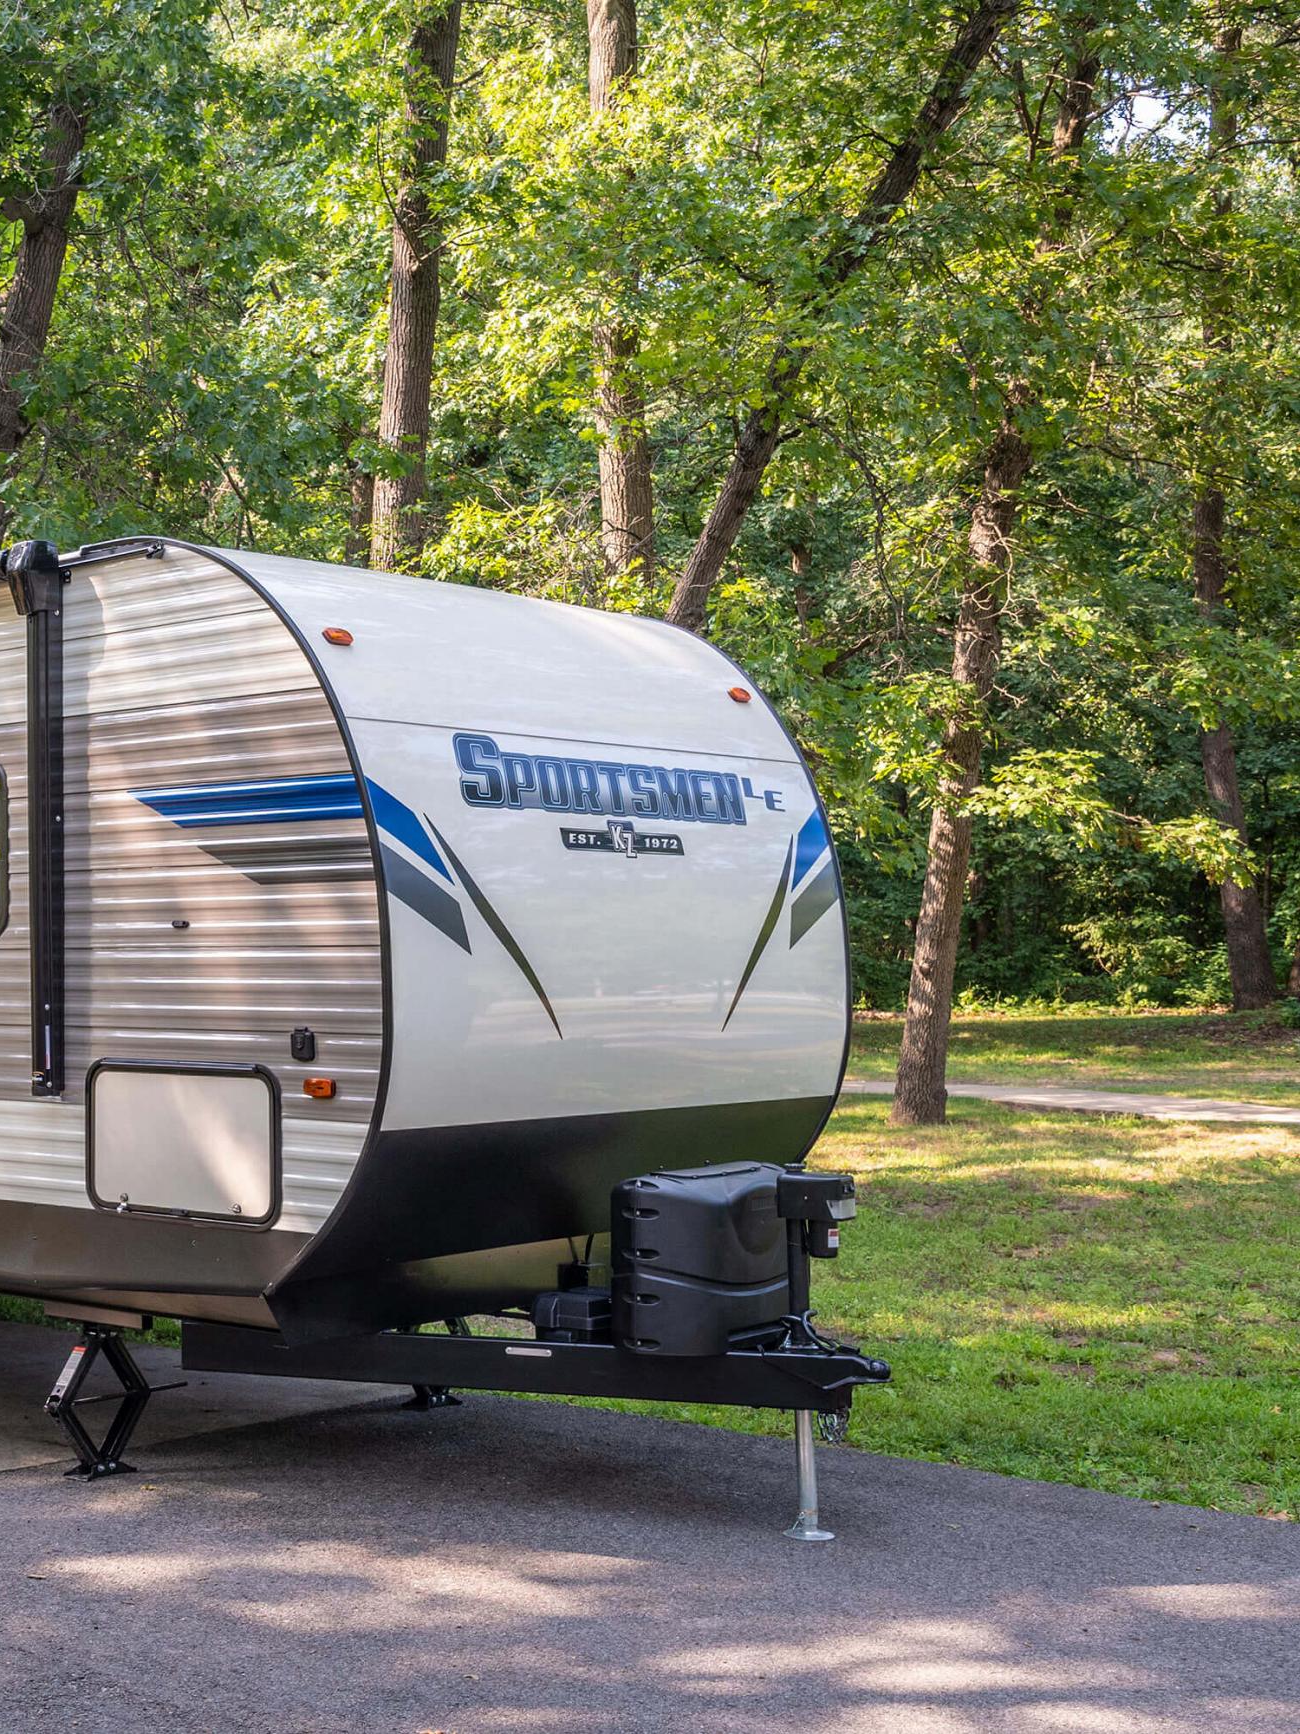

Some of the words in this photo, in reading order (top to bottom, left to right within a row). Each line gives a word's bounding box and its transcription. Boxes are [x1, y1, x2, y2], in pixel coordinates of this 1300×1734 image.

[453, 733, 747, 825] SPORTSMEN
[568, 832, 601, 845] EST.
[643, 838, 679, 850] 1972
